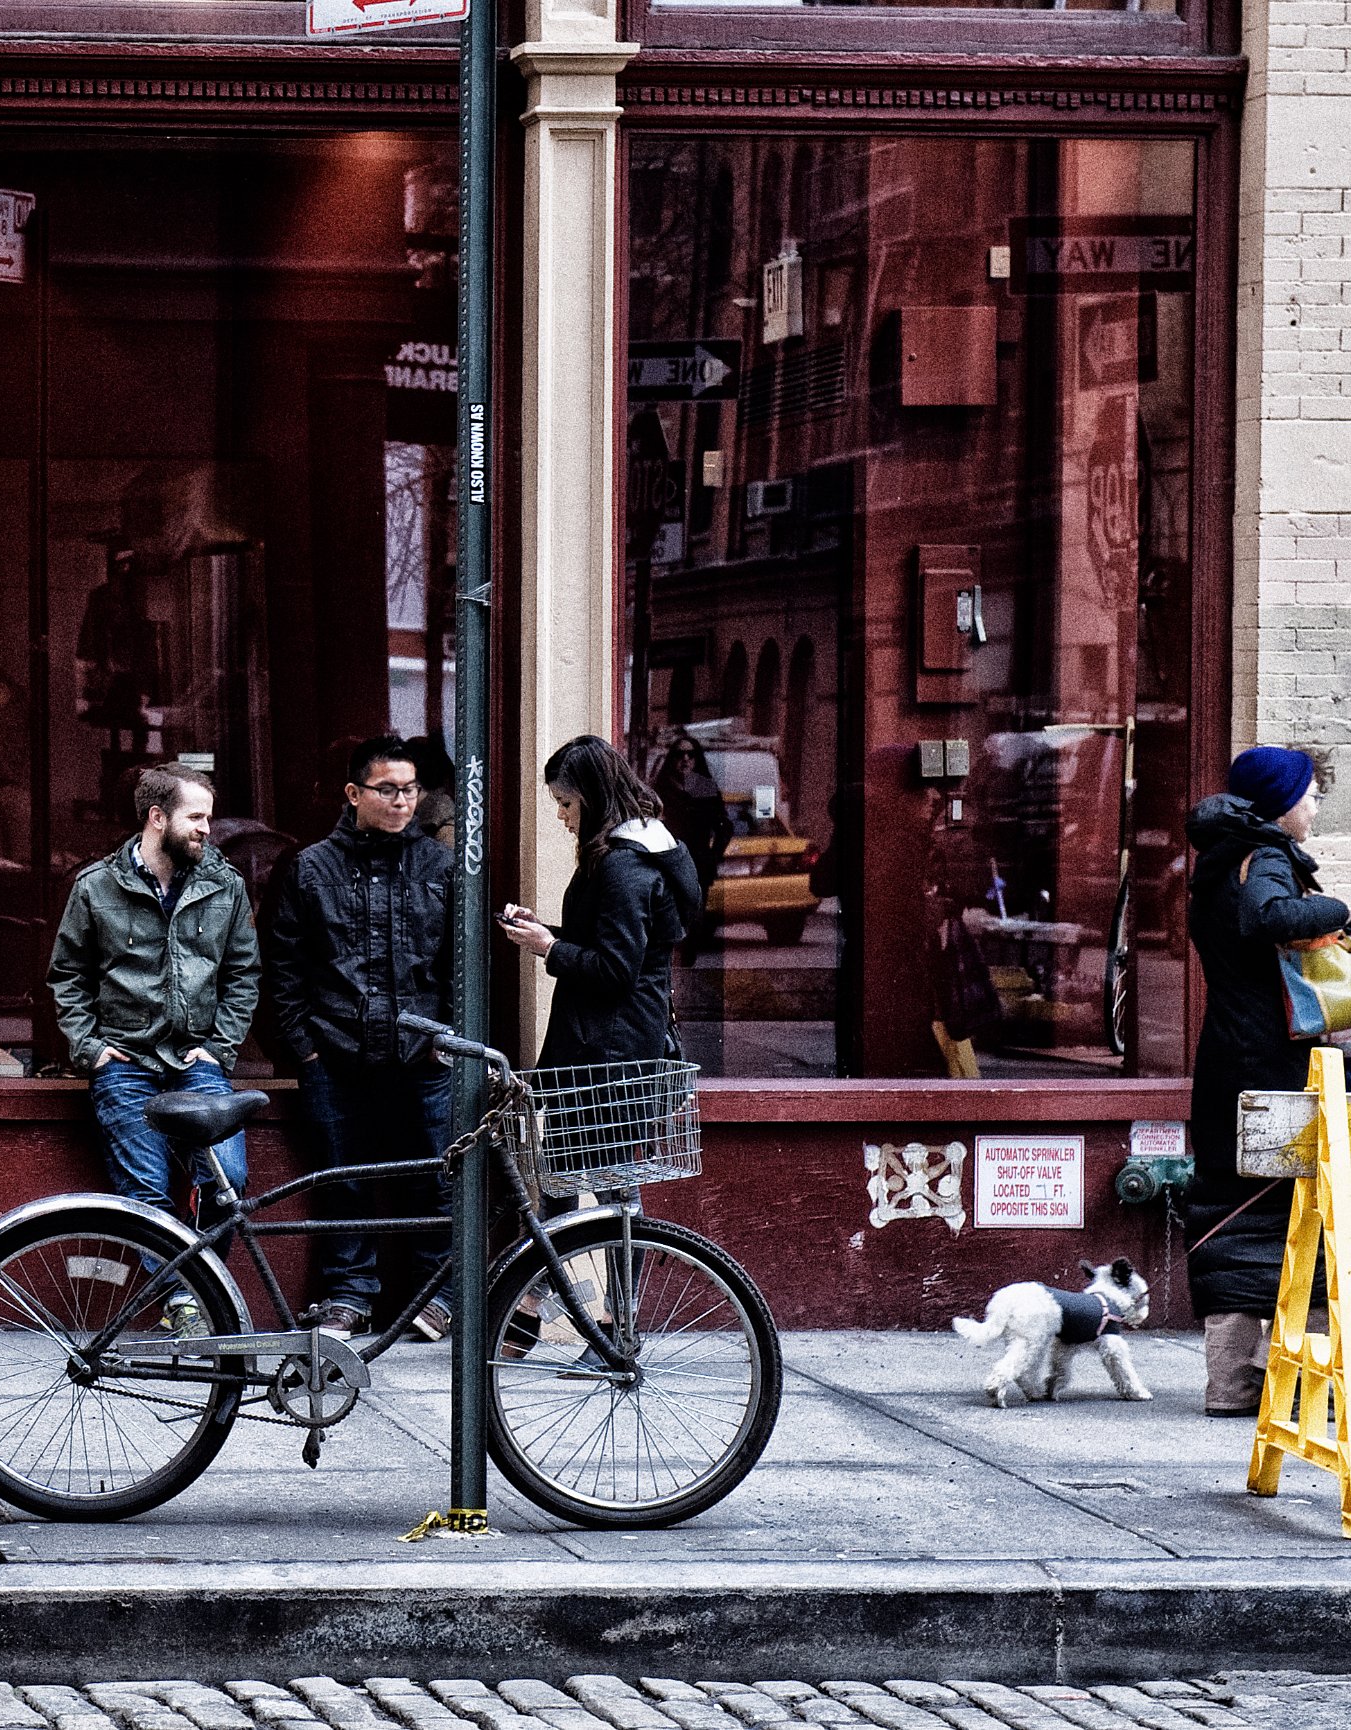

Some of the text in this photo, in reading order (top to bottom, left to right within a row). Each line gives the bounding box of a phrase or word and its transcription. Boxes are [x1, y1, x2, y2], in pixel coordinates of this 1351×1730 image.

[380, 8, 432, 19] TRANSPORTATION
[471, 404, 485, 503] ALSO KNOWN AS
[985, 1147, 1075, 1161] AUTOMATIC SPRINKLER
[997, 1165, 1062, 1179] SHUT-OFF VALVE
[993, 1184, 1030, 1198] LOCATED
[1053, 1184, 1066, 1198] FT.
[990, 1202, 1069, 1216] OPPOSITE THIS SIGN
